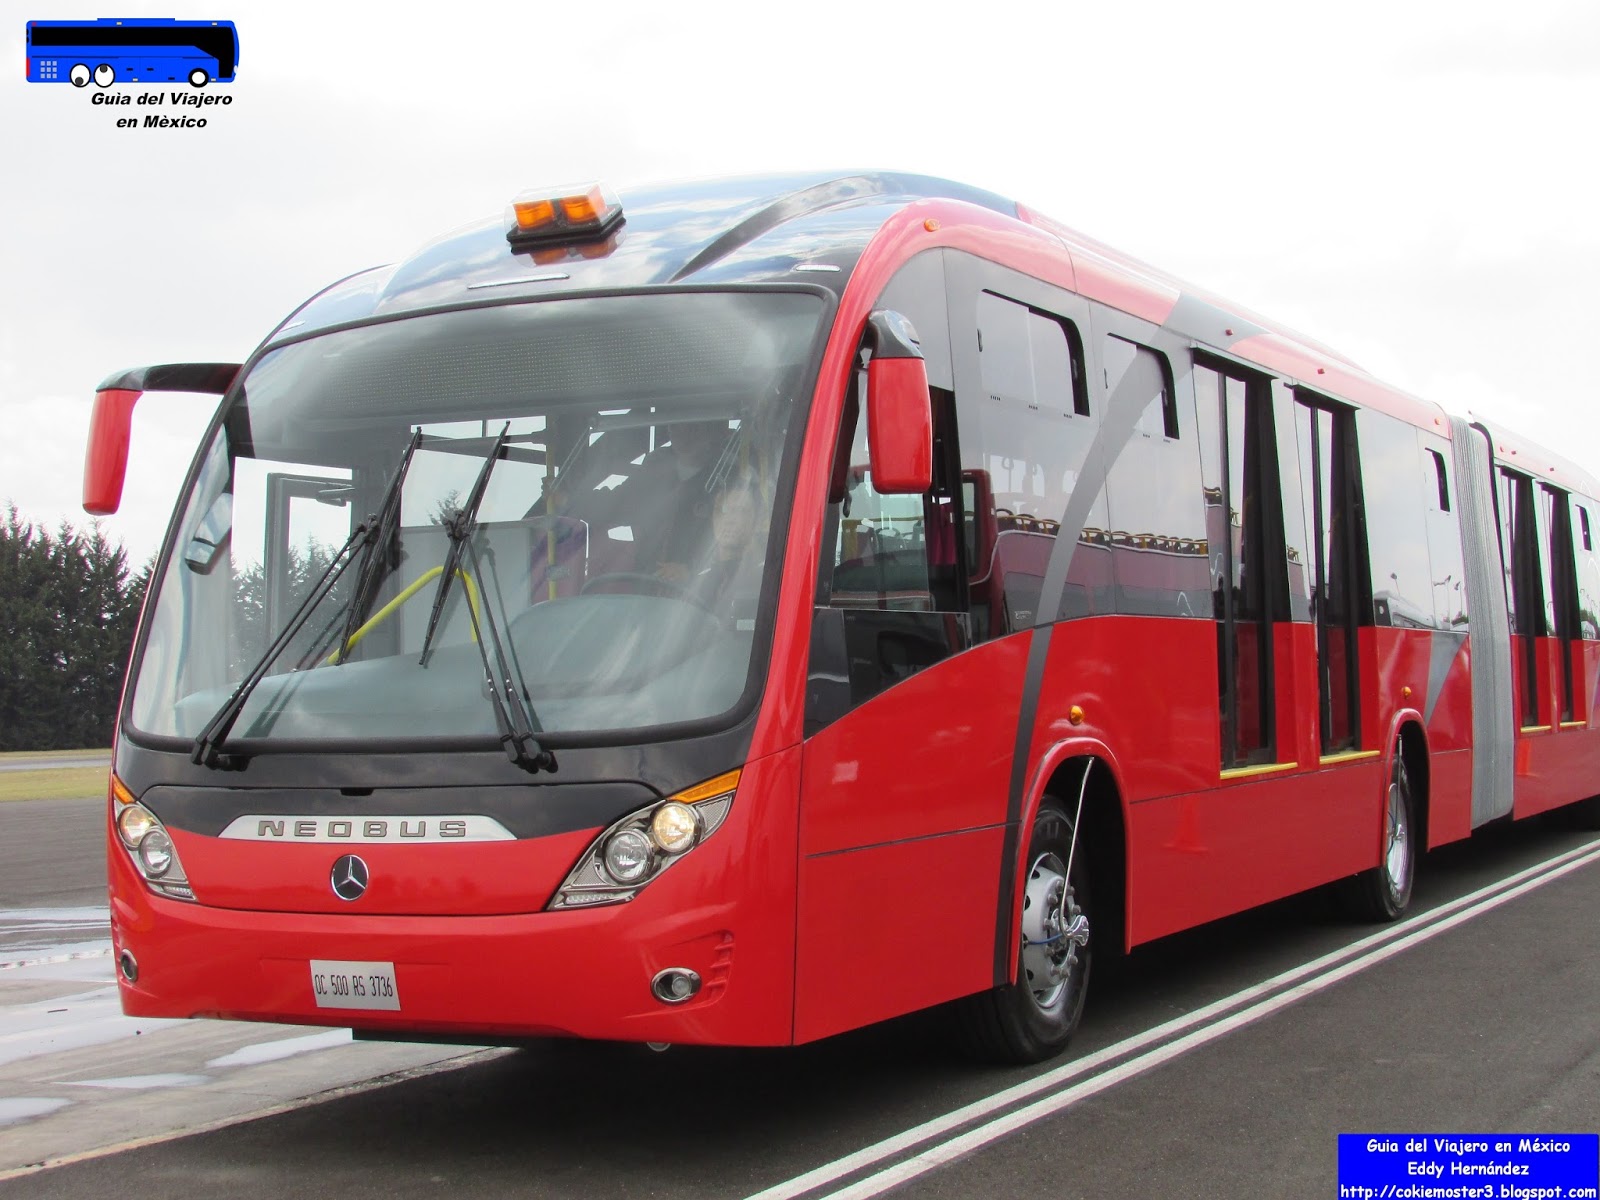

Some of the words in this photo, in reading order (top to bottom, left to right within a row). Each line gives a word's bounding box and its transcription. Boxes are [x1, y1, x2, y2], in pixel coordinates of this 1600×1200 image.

[257, 820, 467, 838] NEOBUS
[331, 975, 349, 996] 500
[352, 976, 366, 997] RS
[369, 976, 393, 998] 3736
